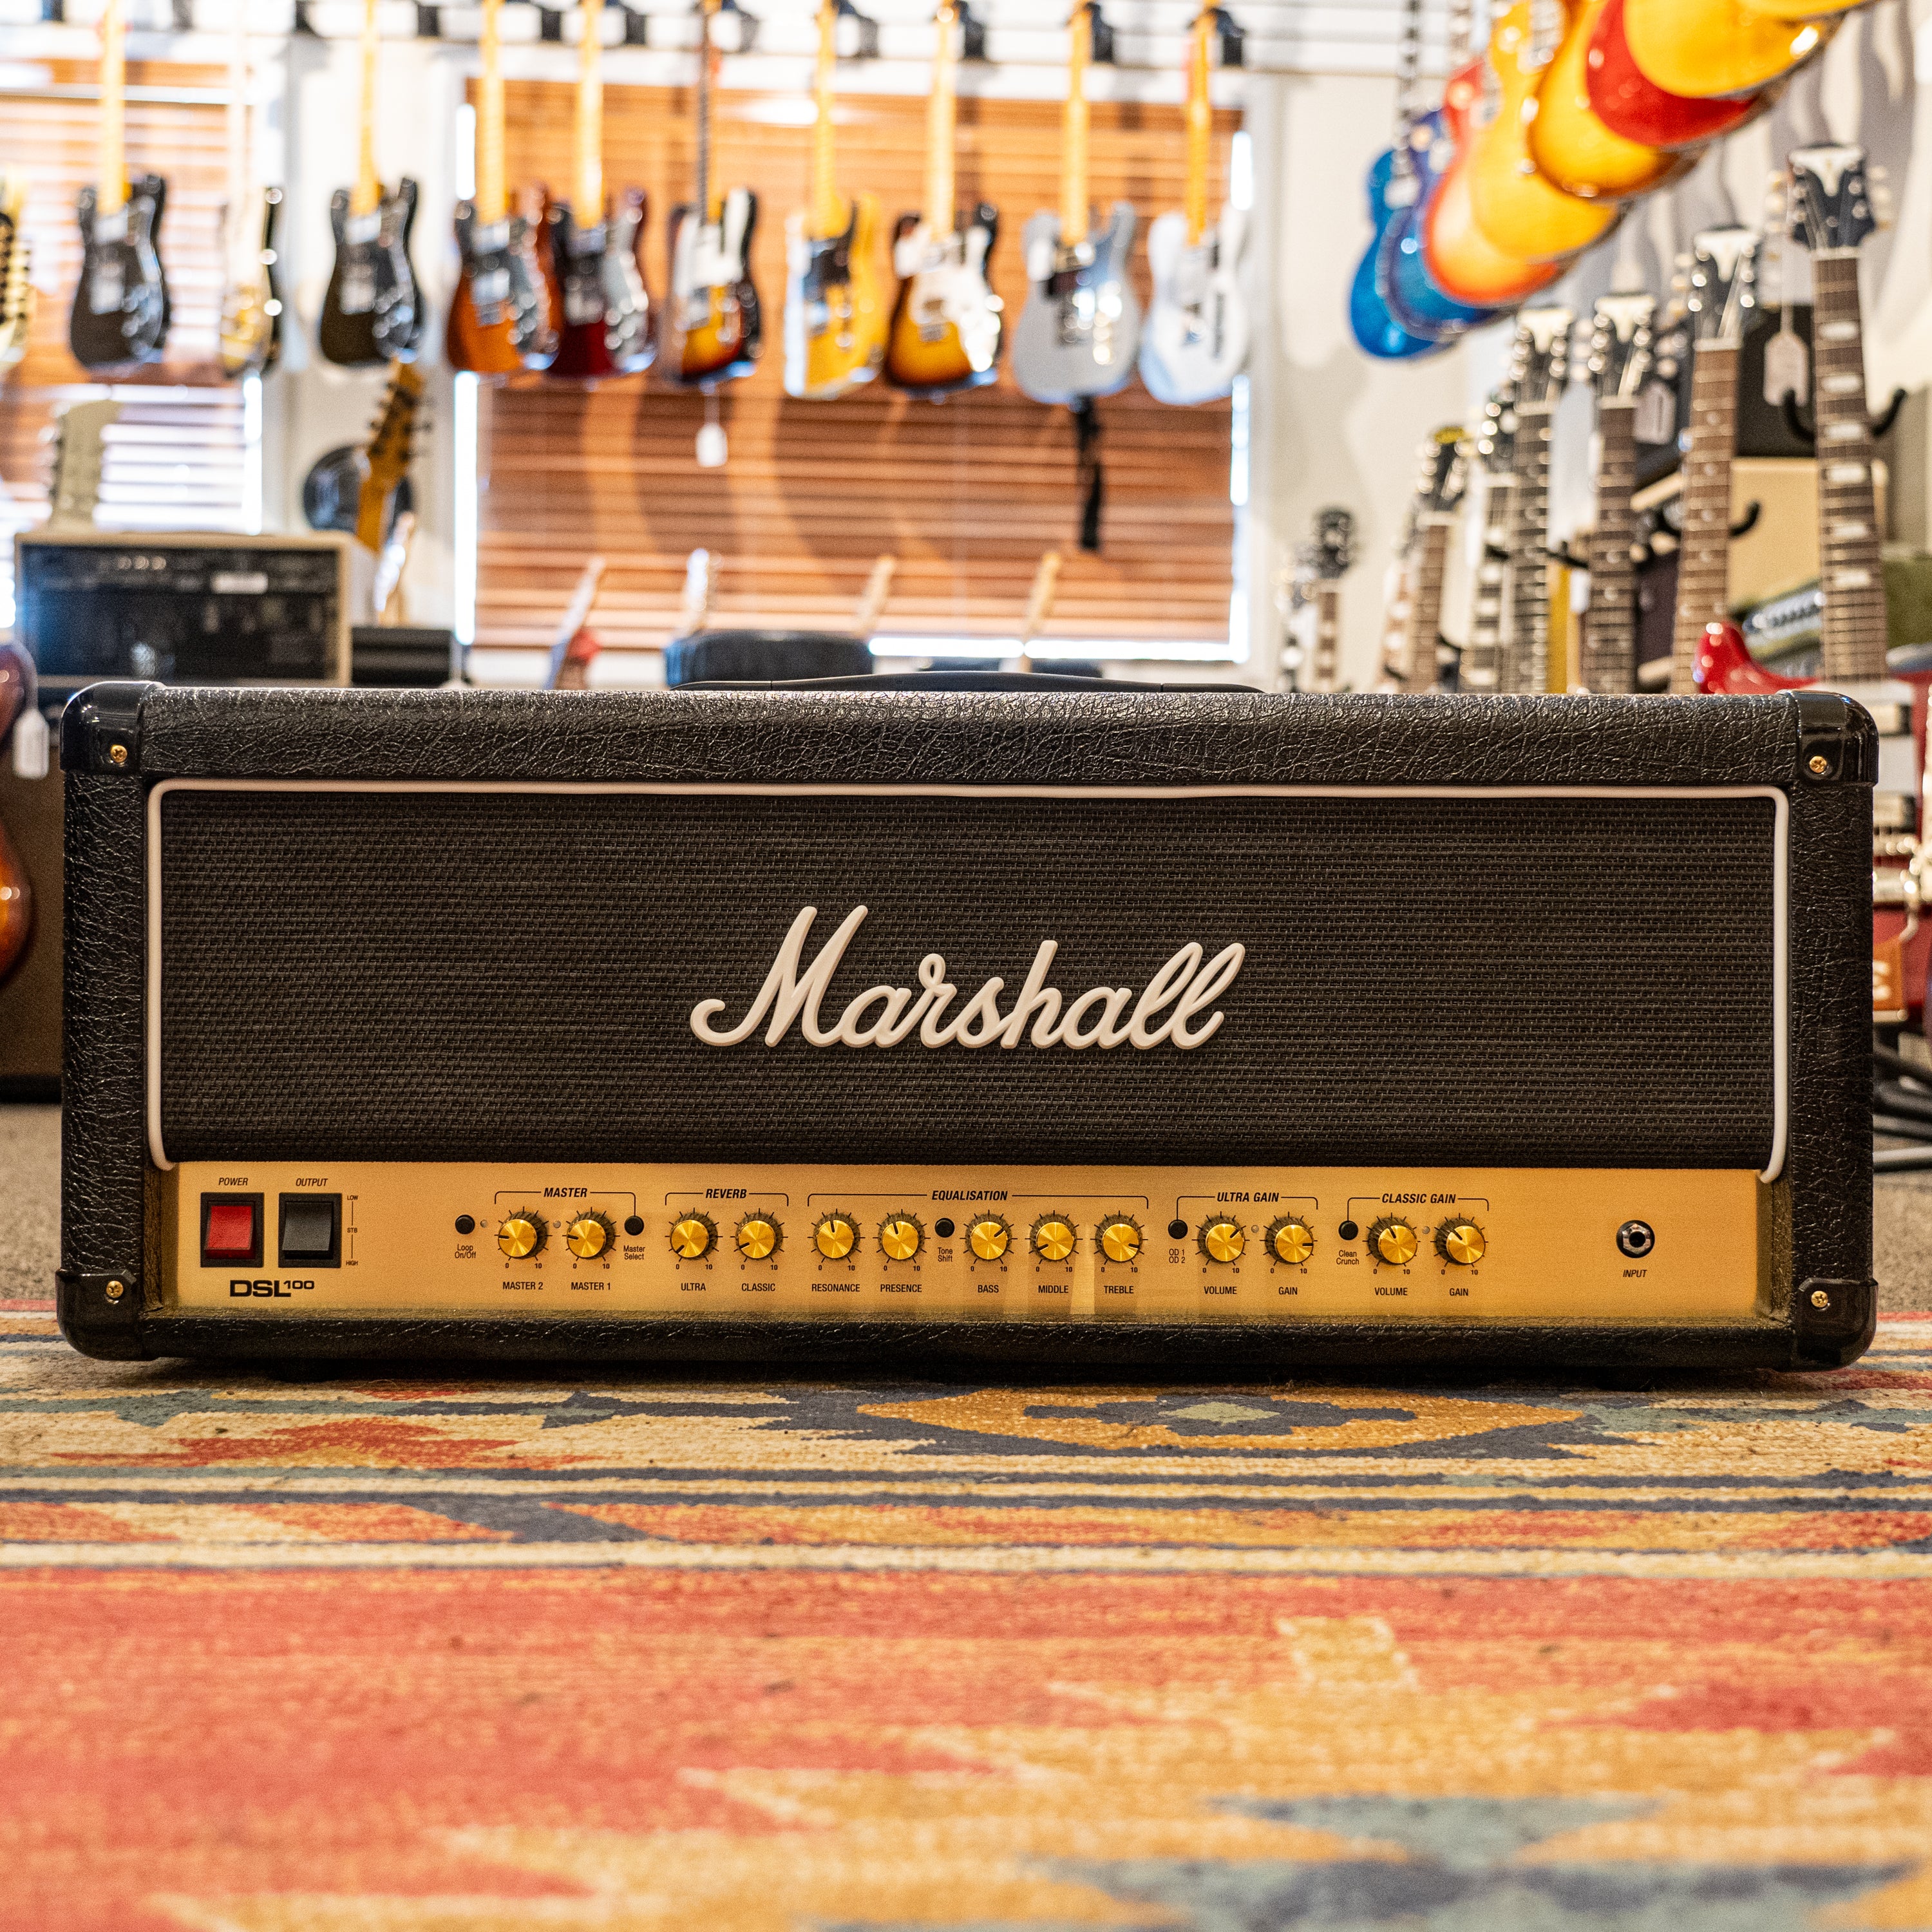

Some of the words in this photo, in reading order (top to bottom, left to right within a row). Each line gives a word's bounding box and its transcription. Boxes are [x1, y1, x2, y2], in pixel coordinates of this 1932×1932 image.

[690, 905, 1245, 1049] Marshall
[218, 1177, 249, 1186] POWER
[296, 1178, 328, 1187] OUTPUT
[544, 1188, 588, 1198] MASTER
[705, 1189, 747, 1198] REVERB
[931, 1190, 1008, 1200] EQUALISATION
[1217, 1192, 1249, 1202] ULTRA
[1253, 1193, 1280, 1202] GAIN
[1381, 1193, 1426, 1204] CLASSIC
[1430, 1193, 1456, 1204] GAIN
[457, 1244, 473, 1252] Loop
[1622, 1269, 1647, 1278] INPUT
[502, 1282, 536, 1290] MASTER
[538, 1282, 544, 1290] 2
[571, 1282, 603, 1291] MASTER
[606, 1282, 611, 1291] 1
[681, 1283, 706, 1291] ULTRA
[741, 1283, 775, 1292] CLASSIC
[811, 1283, 860, 1293] RESONANCE
[880, 1284, 922, 1293] PRESENCE
[978, 1284, 999, 1293] BASS
[1038, 1285, 1069, 1294] MIDDLE
[1103, 1285, 1134, 1294] TREBLE
[1204, 1286, 1237, 1294] VOLUME
[1278, 1287, 1298, 1295] GAIN
[1374, 1287, 1408, 1296] VOLUME
[1449, 1288, 1468, 1296] GAIN
